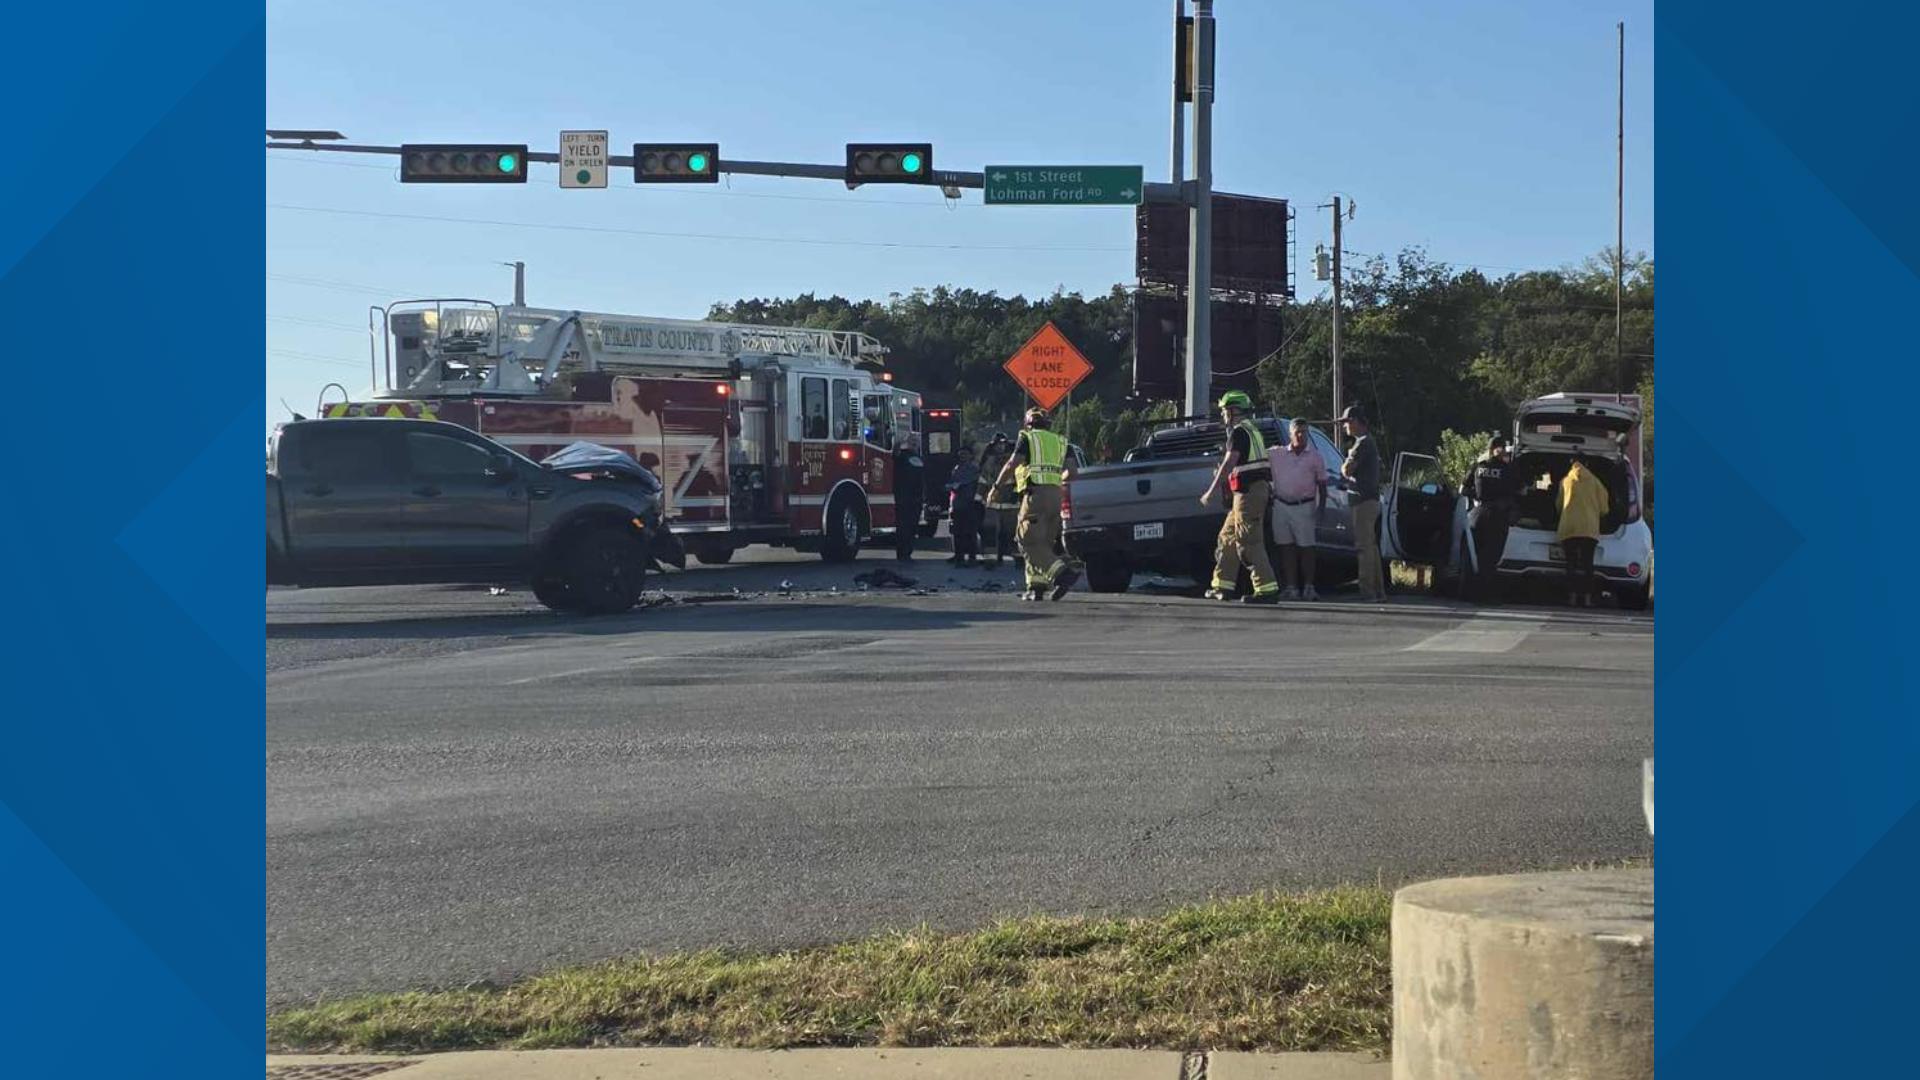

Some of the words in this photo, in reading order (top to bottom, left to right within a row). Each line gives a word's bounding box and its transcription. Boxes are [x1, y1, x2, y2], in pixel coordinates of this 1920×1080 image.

[568, 145, 600, 156] YIELD
[579, 159, 603, 167] GREEN
[1015, 171, 1033, 182] 1st
[1039, 171, 1082, 182] Street
[990, 188, 1046, 200] Lohman
[1053, 188, 1083, 200] Ford
[1088, 188, 1102, 196] RD
[603, 326, 653, 348] TRAVIS
[657, 329, 714, 351] COUNTY
[1032, 346, 1065, 356] RIGHT
[1033, 362, 1064, 372] LANE
[1026, 377, 1071, 388] CLOSED
[1478, 467, 1503, 479] POLICE
